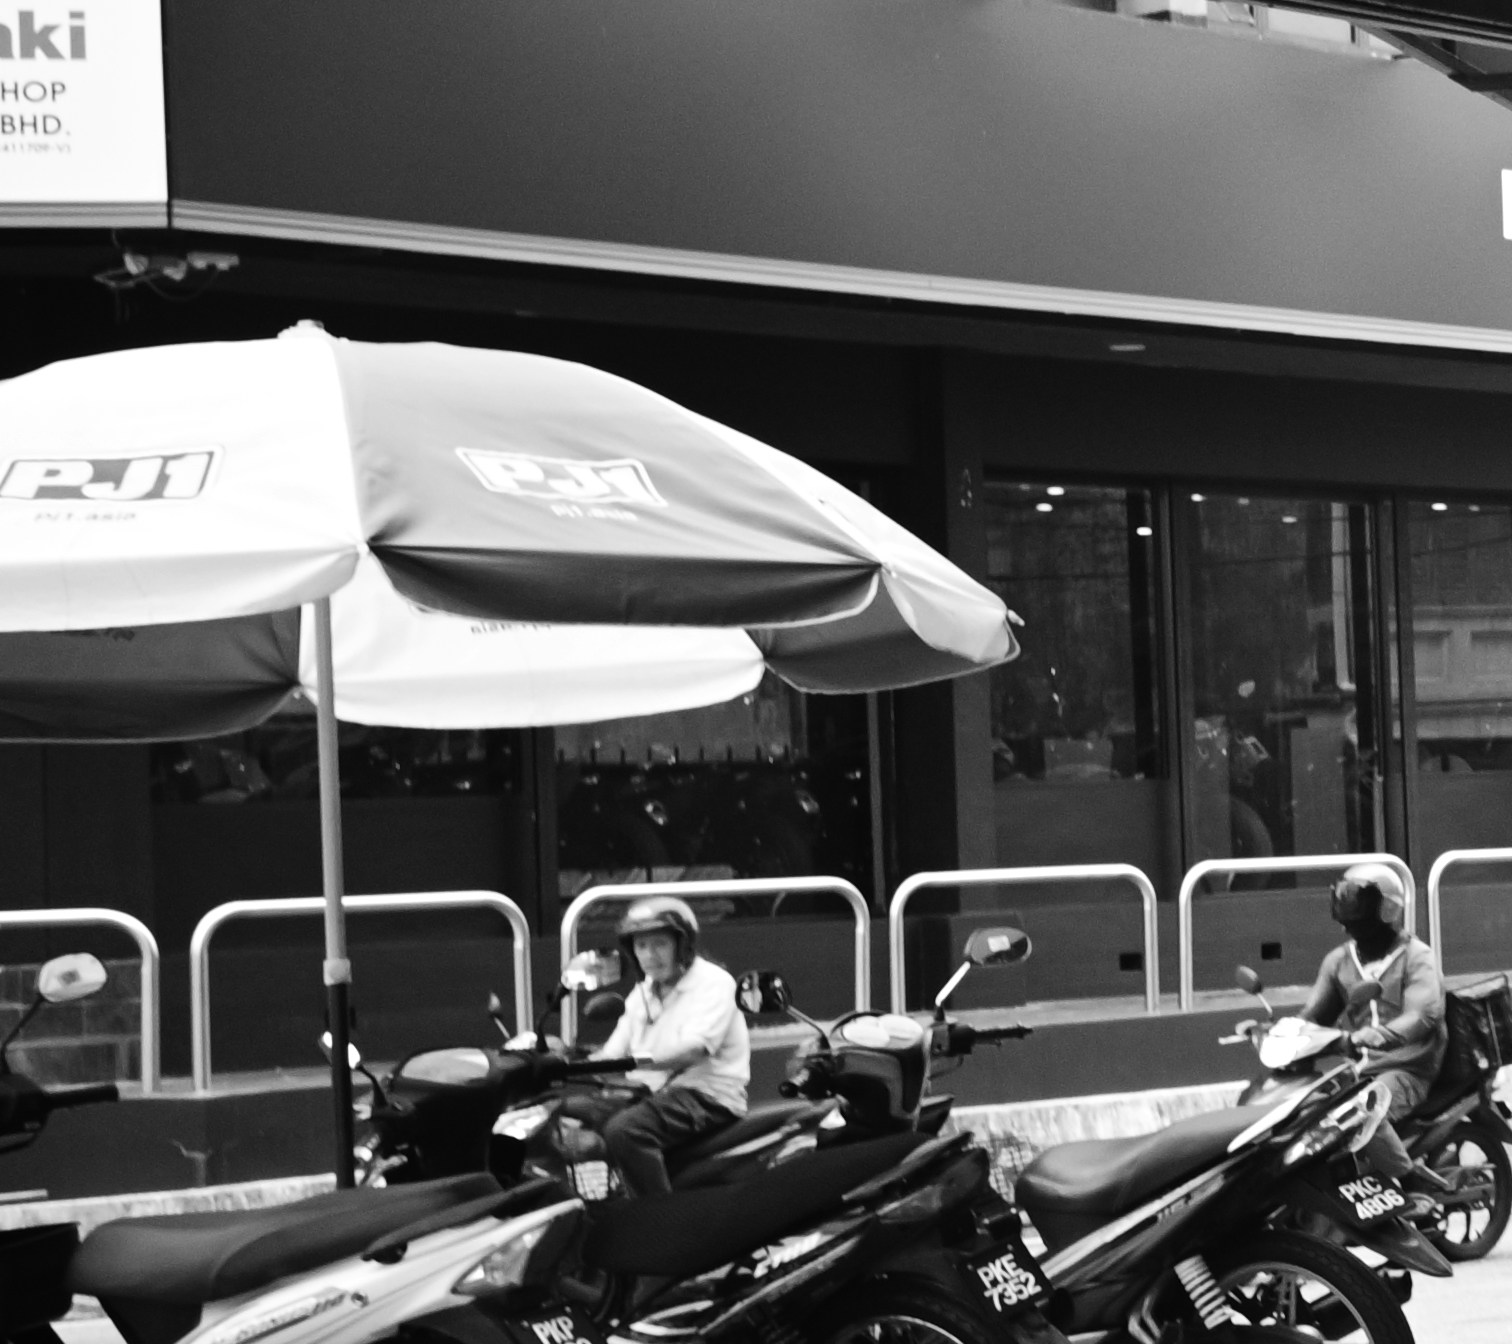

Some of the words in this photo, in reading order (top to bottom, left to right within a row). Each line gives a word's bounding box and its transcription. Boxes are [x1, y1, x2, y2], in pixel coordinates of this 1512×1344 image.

[1, 114, 71, 136] BHD.
[461, 452, 658, 503] PJ1
[1338, 1176, 1383, 1204] PKC
[977, 1253, 1025, 1290] PKE
[984, 1268, 1043, 1313] 7352
